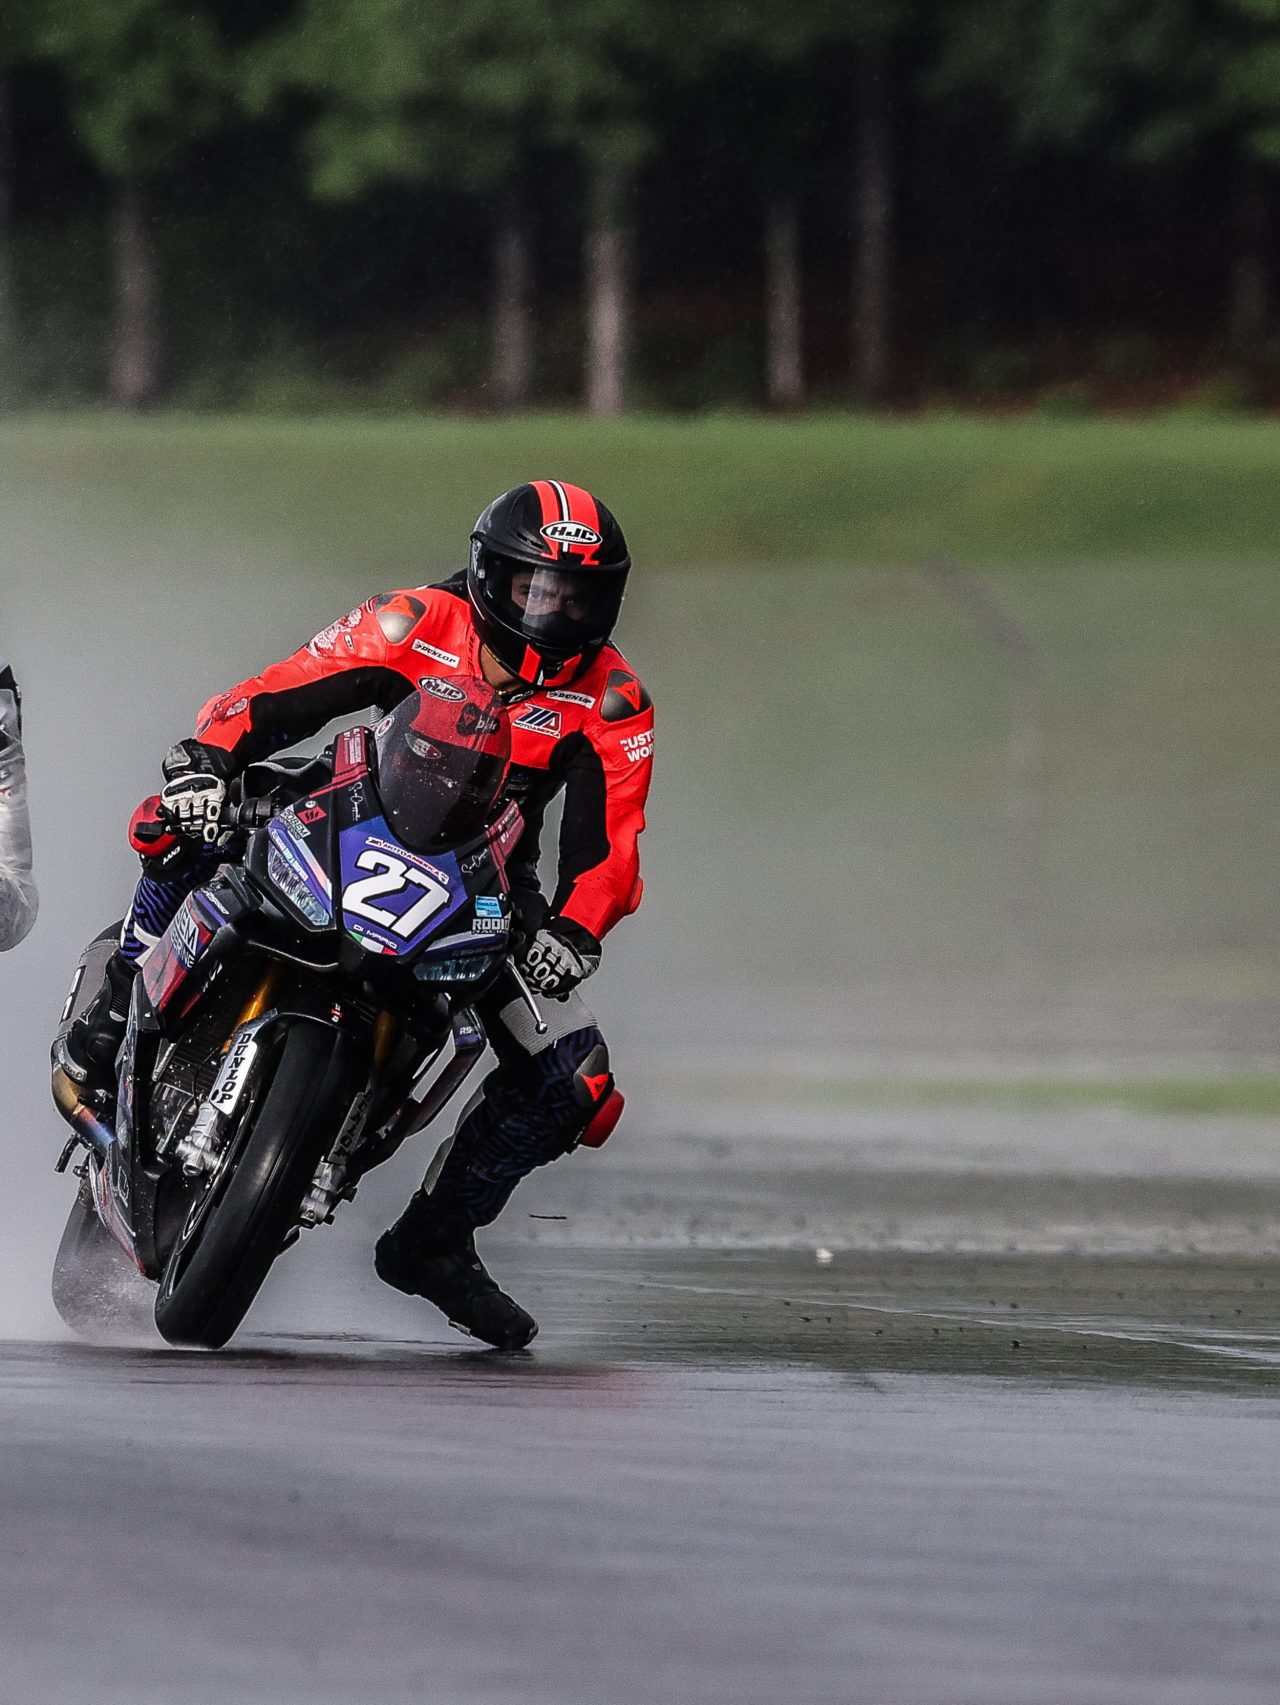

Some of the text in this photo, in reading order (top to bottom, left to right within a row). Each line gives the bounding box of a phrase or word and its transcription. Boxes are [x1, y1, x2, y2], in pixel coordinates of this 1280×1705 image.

[550, 526, 594, 541] HJC
[420, 646, 457, 664] DUNLOP
[423, 680, 460, 698] HJC
[558, 692, 592, 704] DUNLOP
[342, 849, 450, 938] 27
[366, 929, 398, 950] MARIO
[216, 1032, 252, 1104] DUNLOP
